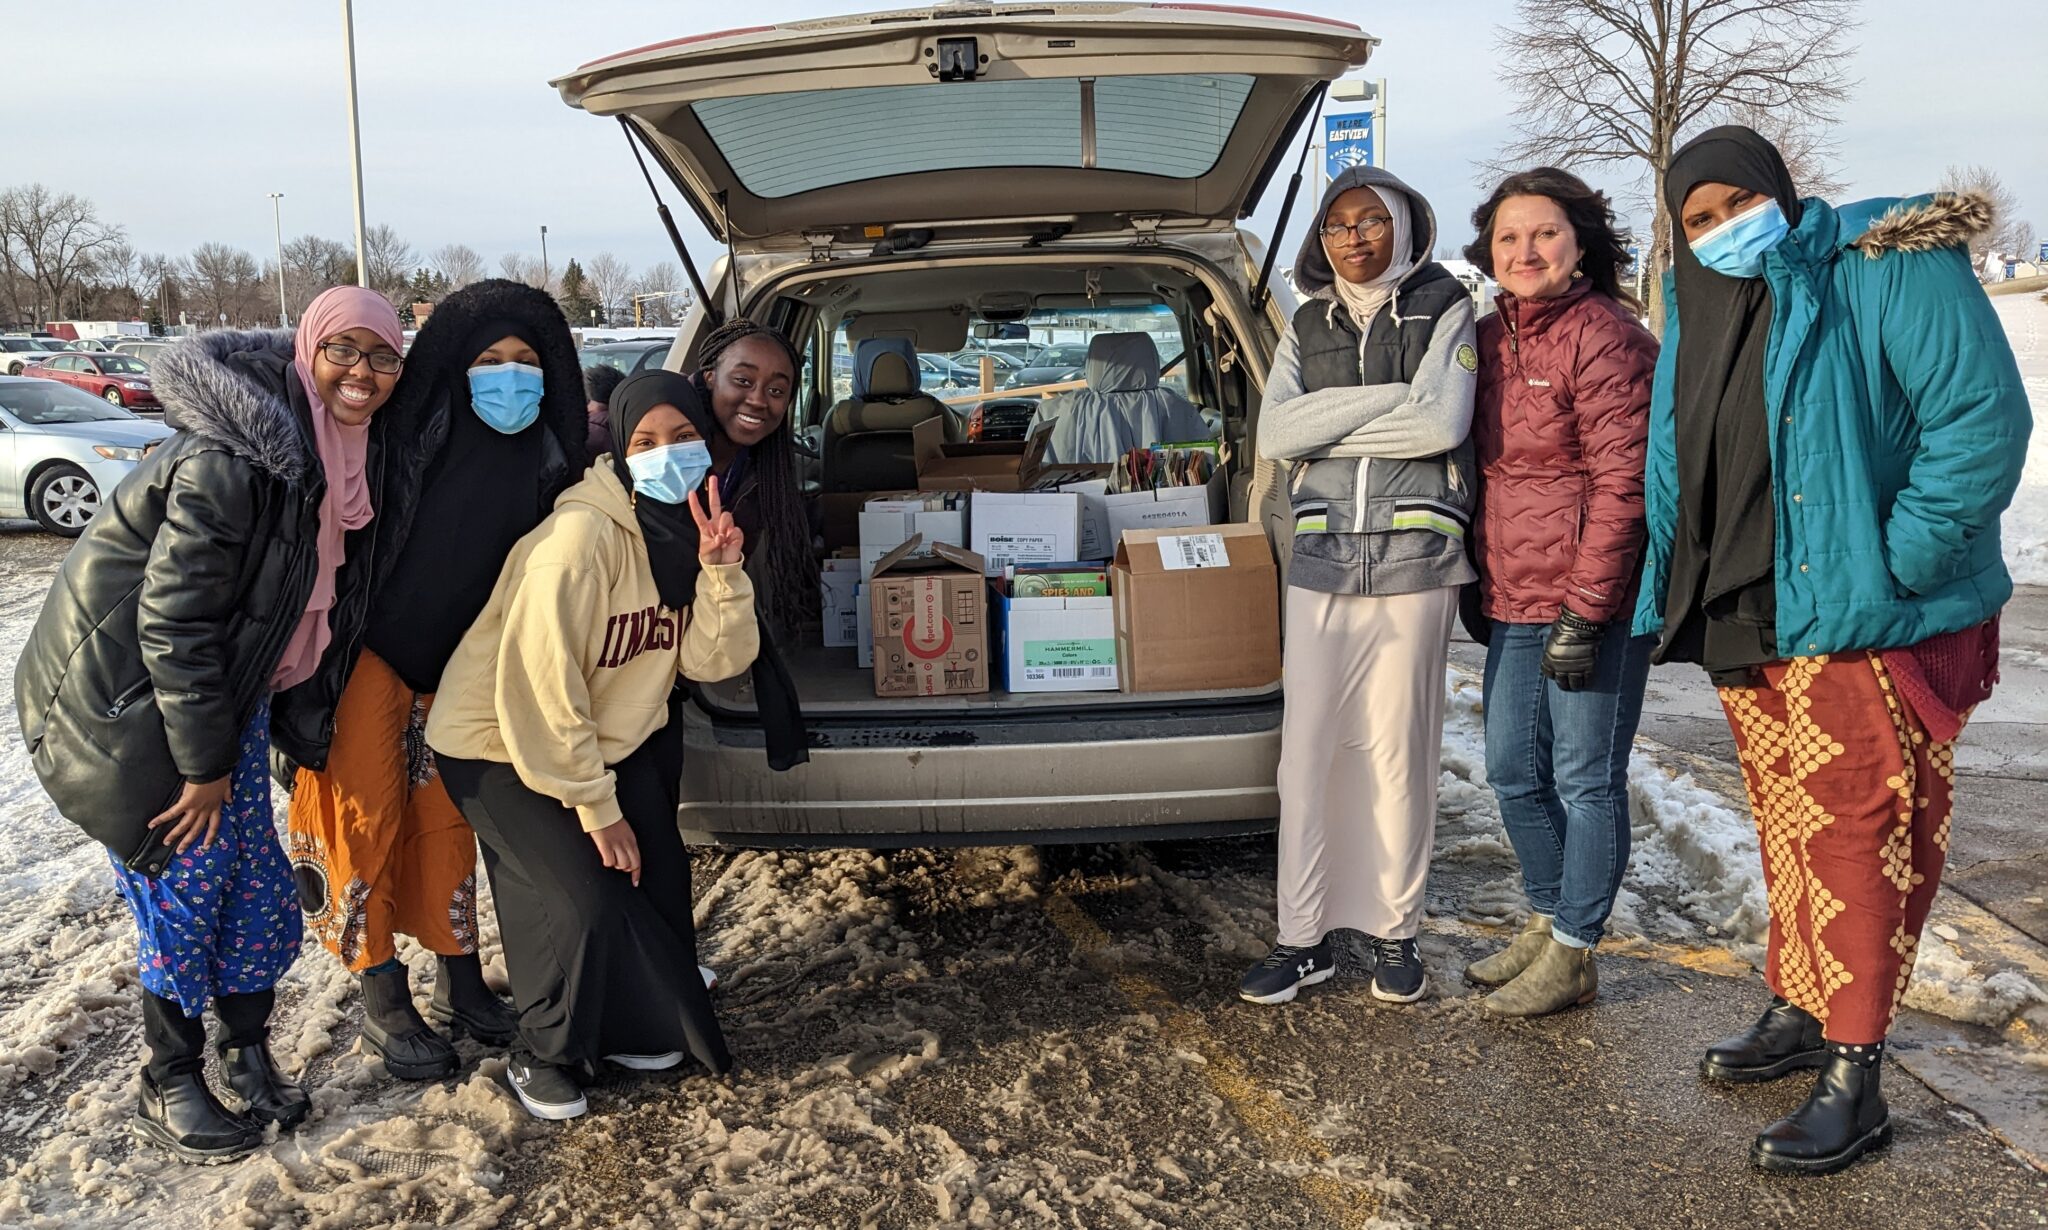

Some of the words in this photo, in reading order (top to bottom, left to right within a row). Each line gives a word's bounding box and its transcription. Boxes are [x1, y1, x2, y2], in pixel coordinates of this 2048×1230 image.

[1337, 120, 1347, 128] WE
[1348, 119, 1363, 128] ARE
[1329, 128, 1369, 141] EASTVIEW
[1041, 588, 1070, 597] SPIES
[1073, 586, 1095, 597] AND
